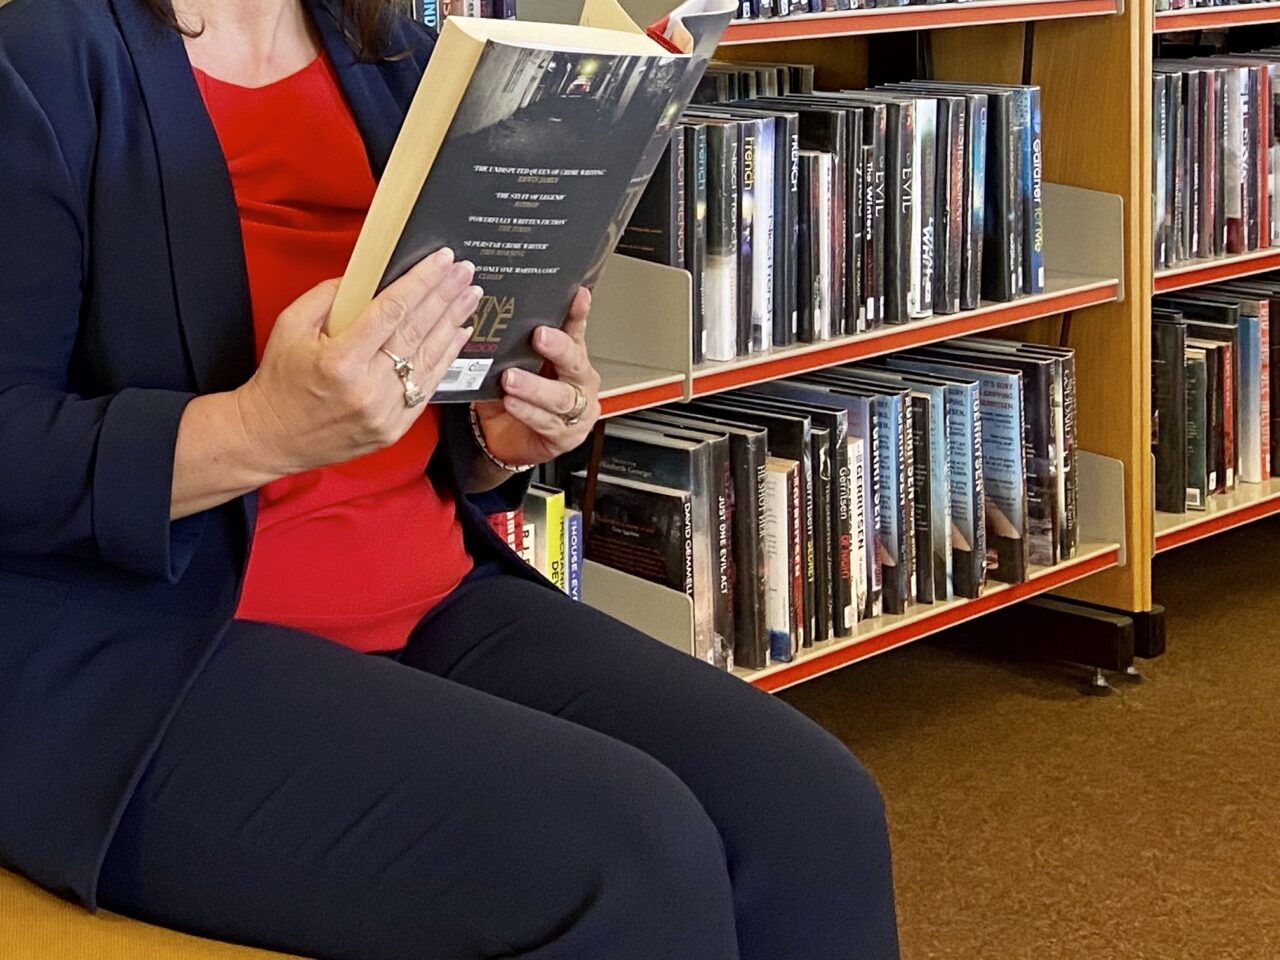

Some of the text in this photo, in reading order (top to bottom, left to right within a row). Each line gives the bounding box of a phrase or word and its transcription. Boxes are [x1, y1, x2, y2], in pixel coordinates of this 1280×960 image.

[744, 136, 756, 191] French
[1032, 139, 1042, 205] Gardner
[677, 136, 685, 263] NICCI FRENCH
[839, 467, 849, 520] Gerritsen
